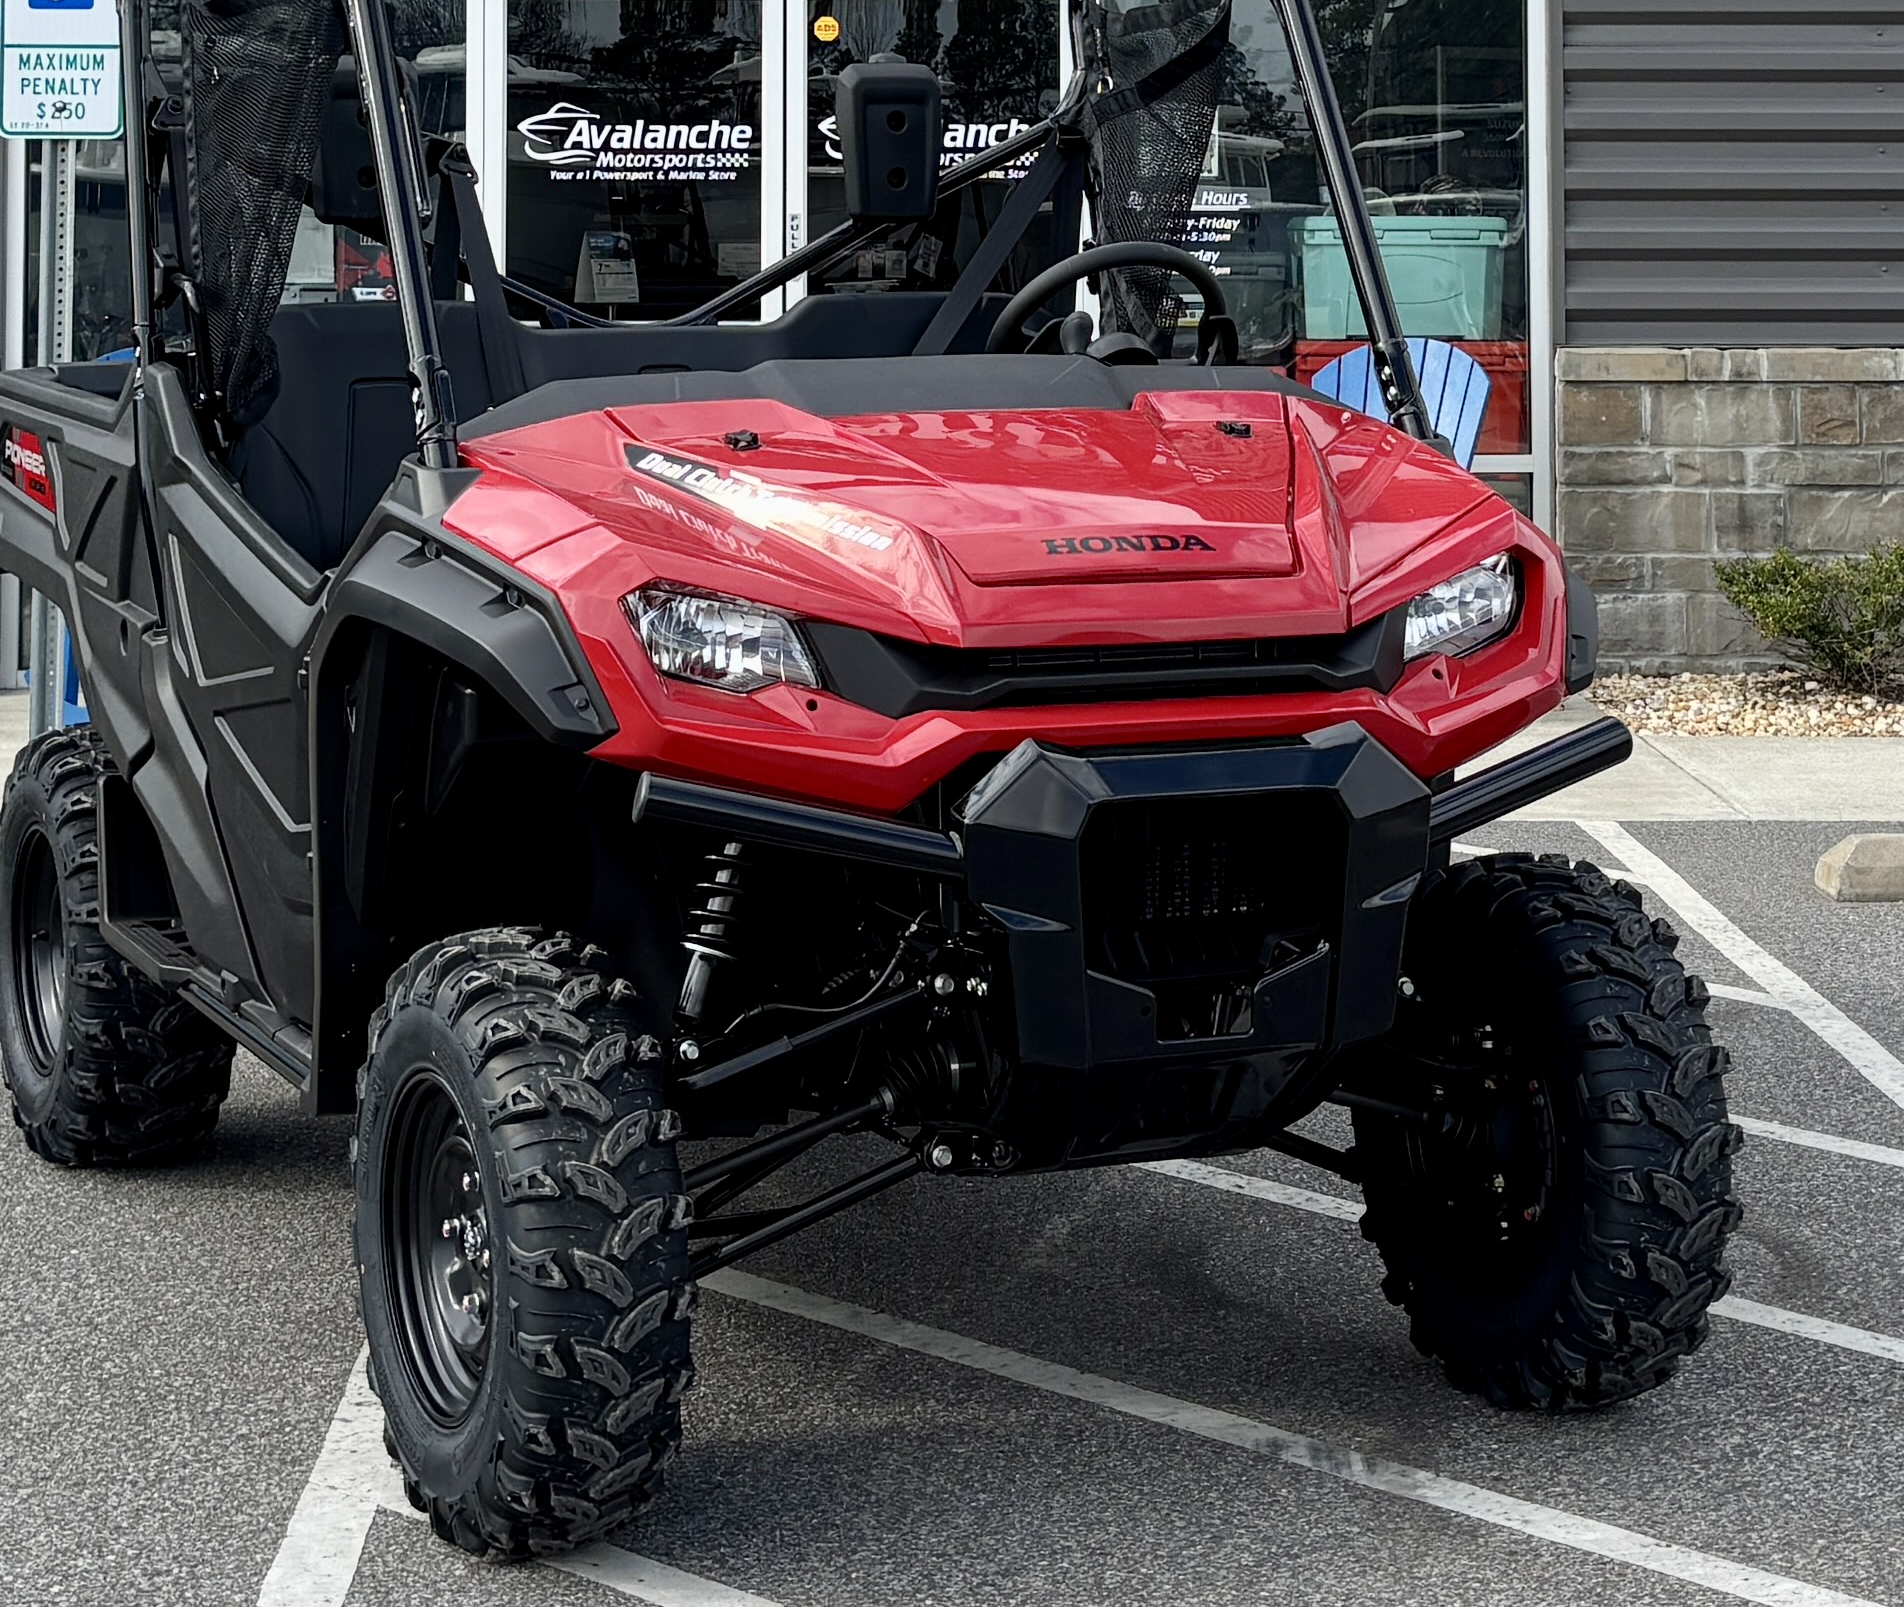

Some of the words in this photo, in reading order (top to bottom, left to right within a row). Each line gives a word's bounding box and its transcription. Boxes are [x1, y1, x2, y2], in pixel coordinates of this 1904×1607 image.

[19, 53, 105, 71] MAXIMUM
[21, 78, 101, 95] PENALTY
[563, 120, 752, 149] Avalanche
[596, 152, 716, 170] Motorsports
[550, 171, 573, 180] Your
[592, 171, 654, 181] Powersport
[656, 171, 665, 180] &
[668, 171, 705, 180] Marine
[708, 171, 738, 181] Store
[1201, 191, 1249, 206] Hours
[636, 451, 689, 480] Dual
[684, 468, 752, 500] Clutch
[1040, 534, 1217, 555] HONDA
